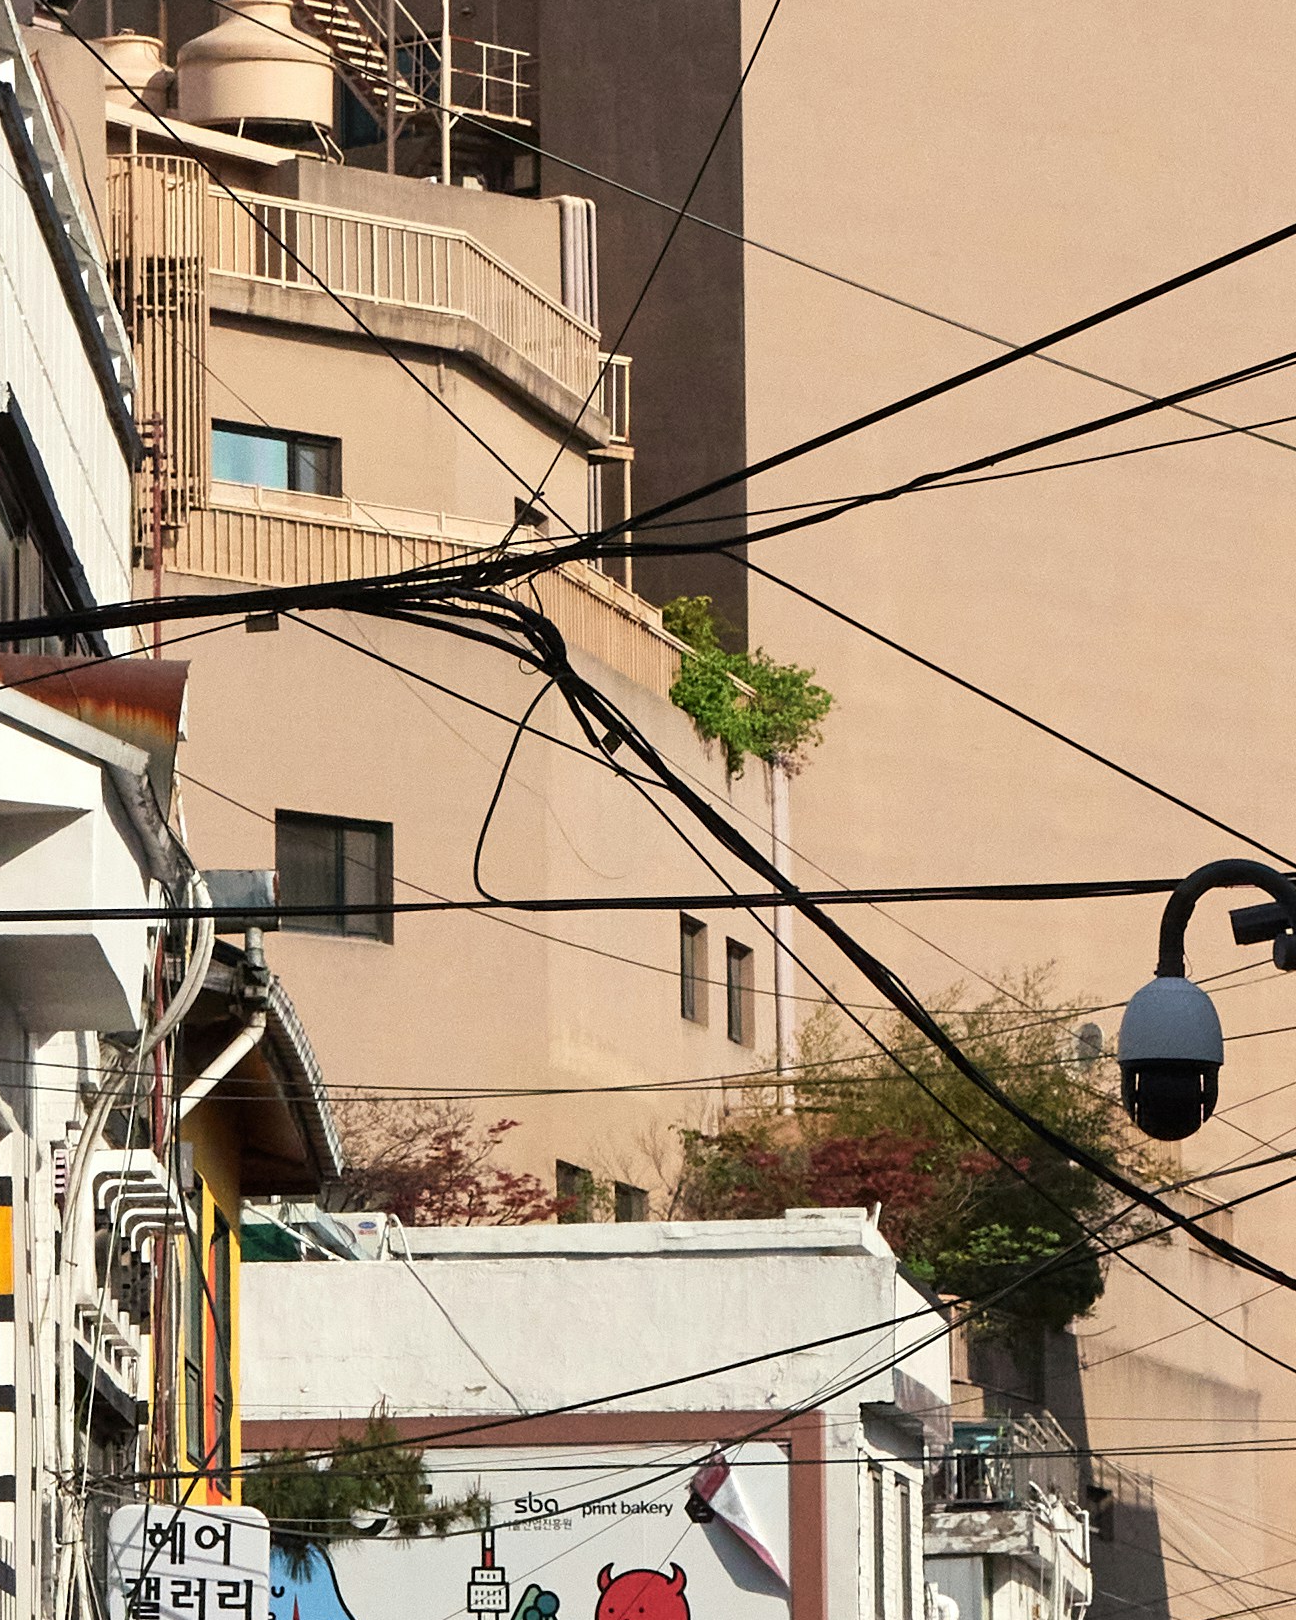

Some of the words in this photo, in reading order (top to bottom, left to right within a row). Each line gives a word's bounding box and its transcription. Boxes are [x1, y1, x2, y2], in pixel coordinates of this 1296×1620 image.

[514, 1491, 559, 1514] sba
[582, 1501, 616, 1518] print
[621, 1500, 673, 1516] bakery
[146, 1522, 231, 1566] 헤어
